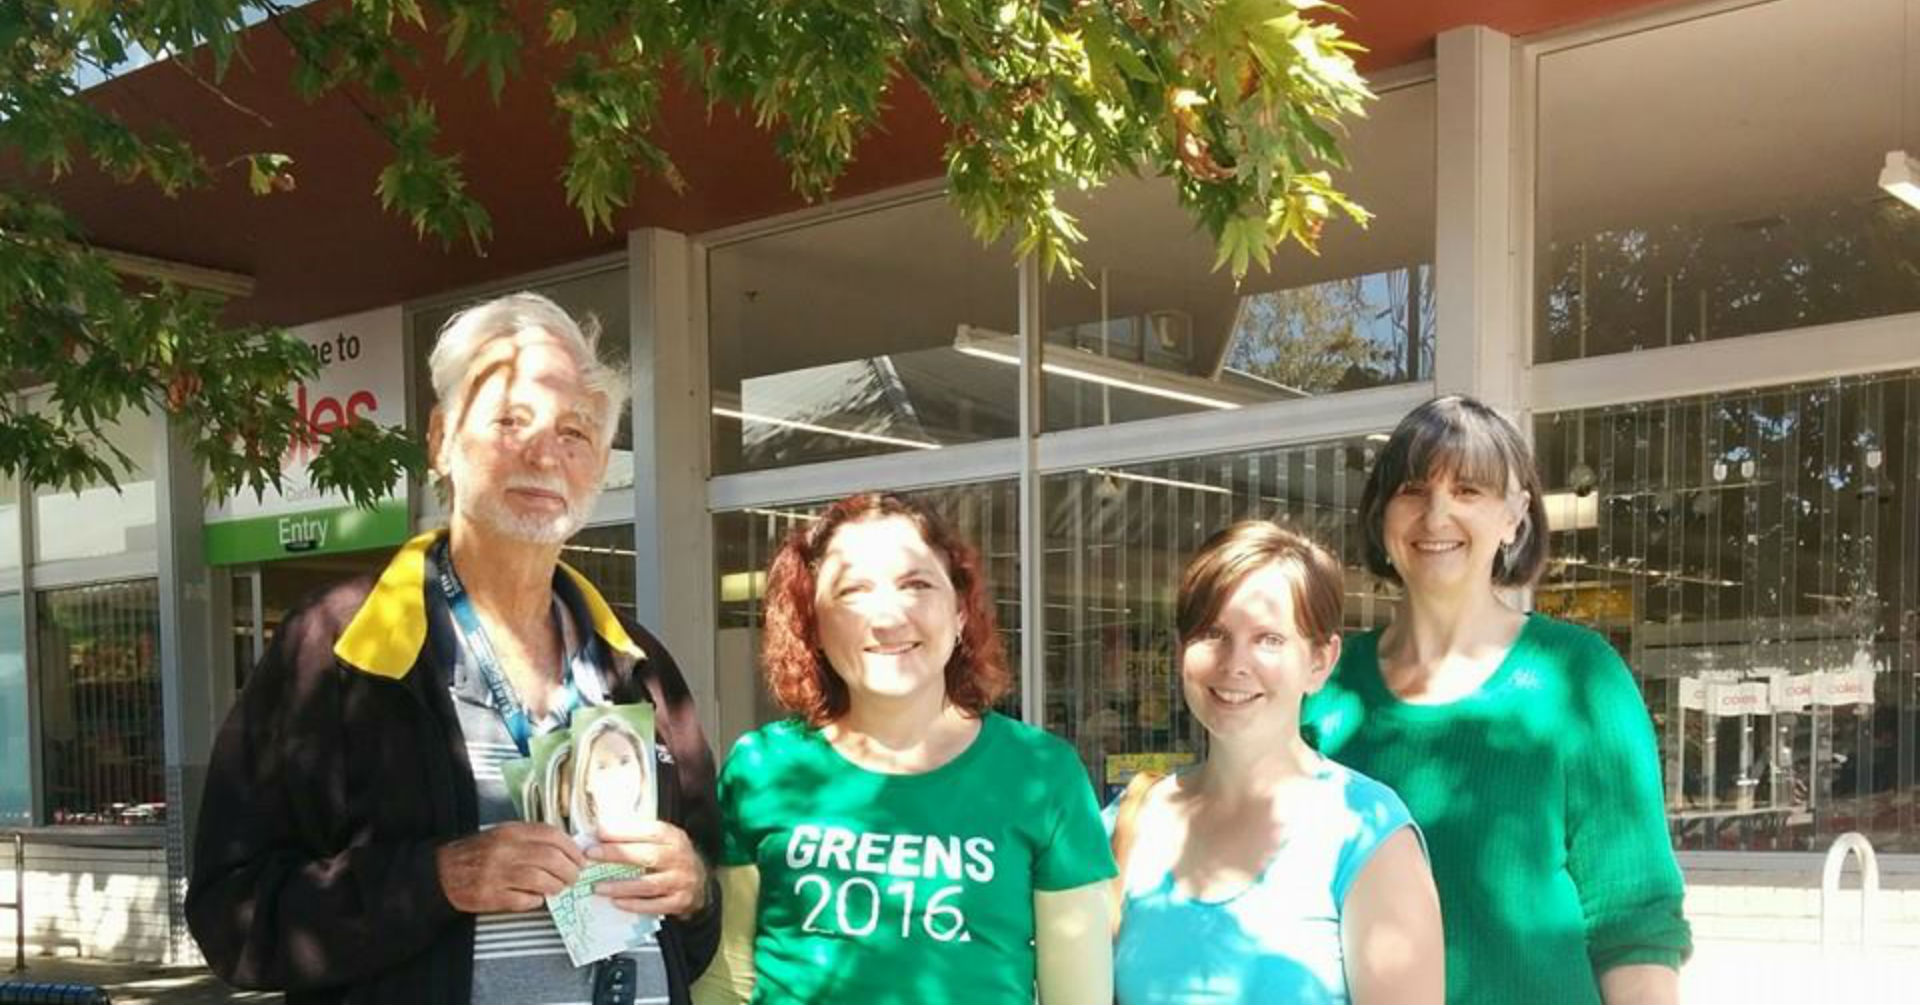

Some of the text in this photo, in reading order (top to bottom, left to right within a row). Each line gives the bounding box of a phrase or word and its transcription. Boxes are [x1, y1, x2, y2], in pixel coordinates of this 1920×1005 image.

[336, 332, 360, 362] to
[278, 516, 329, 546] Entry
[786, 824, 996, 883] GREENS
